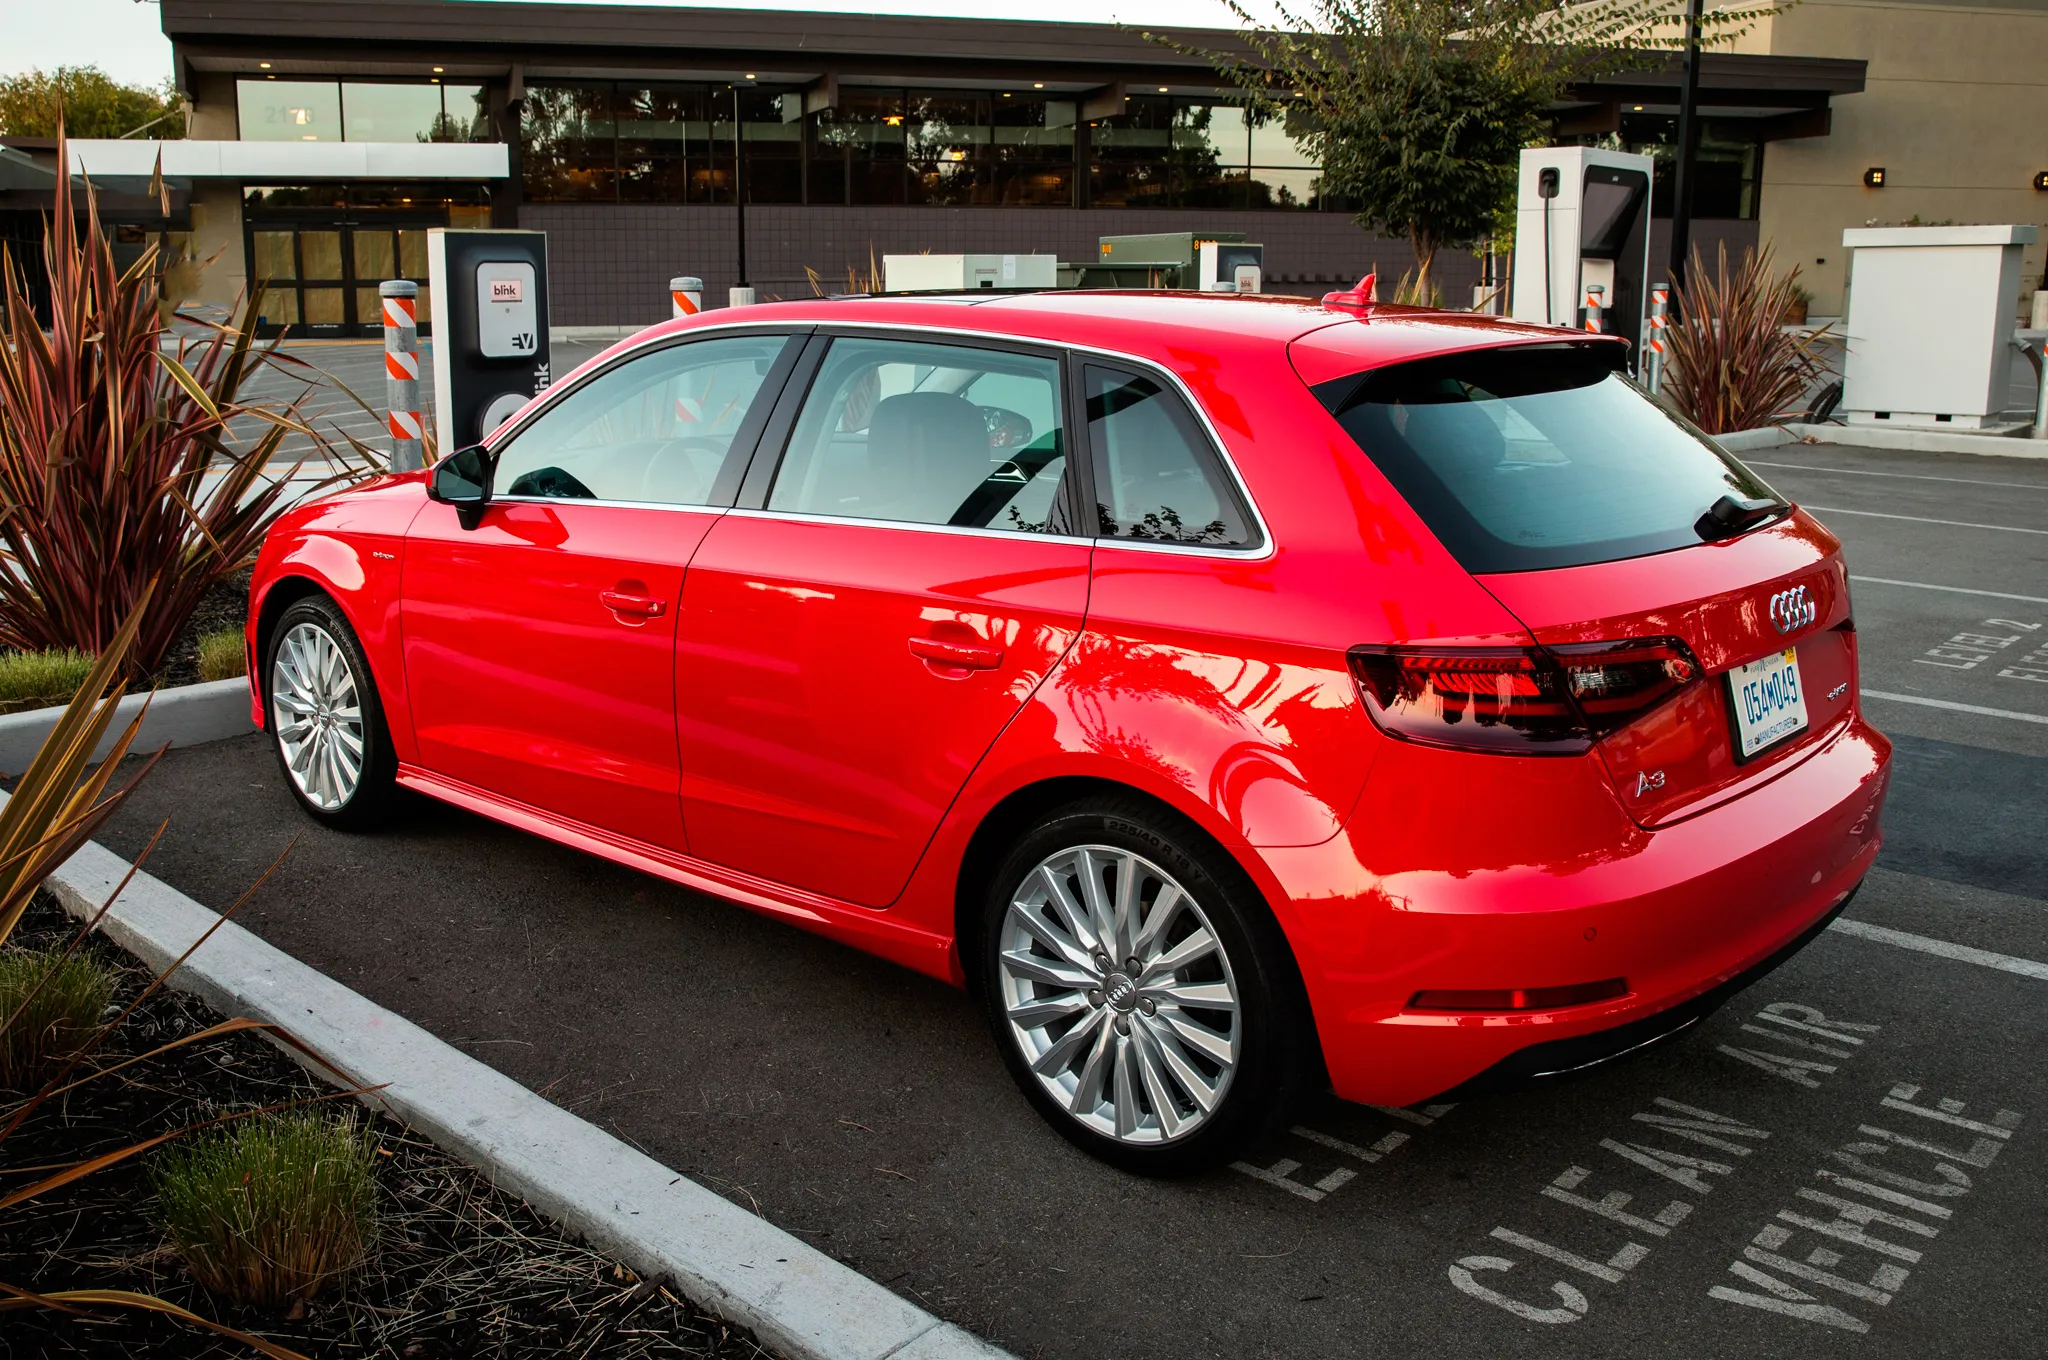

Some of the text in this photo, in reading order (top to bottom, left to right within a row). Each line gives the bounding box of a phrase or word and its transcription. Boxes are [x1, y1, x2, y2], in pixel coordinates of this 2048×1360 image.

[493, 284, 516, 296] blink
[512, 333, 534, 349] EV
[534, 362, 550, 395] link
[1913, 632, 2022, 670] LEVEL
[1743, 665, 1798, 725] 054M049
[1635, 770, 1665, 797] A3
[1109, 820, 1160, 847] 225/40
[1162, 844, 1173, 855] R
[1448, 1002, 1881, 1324] CLEAN AIR
[1707, 1082, 2026, 1333] VEHICLE
